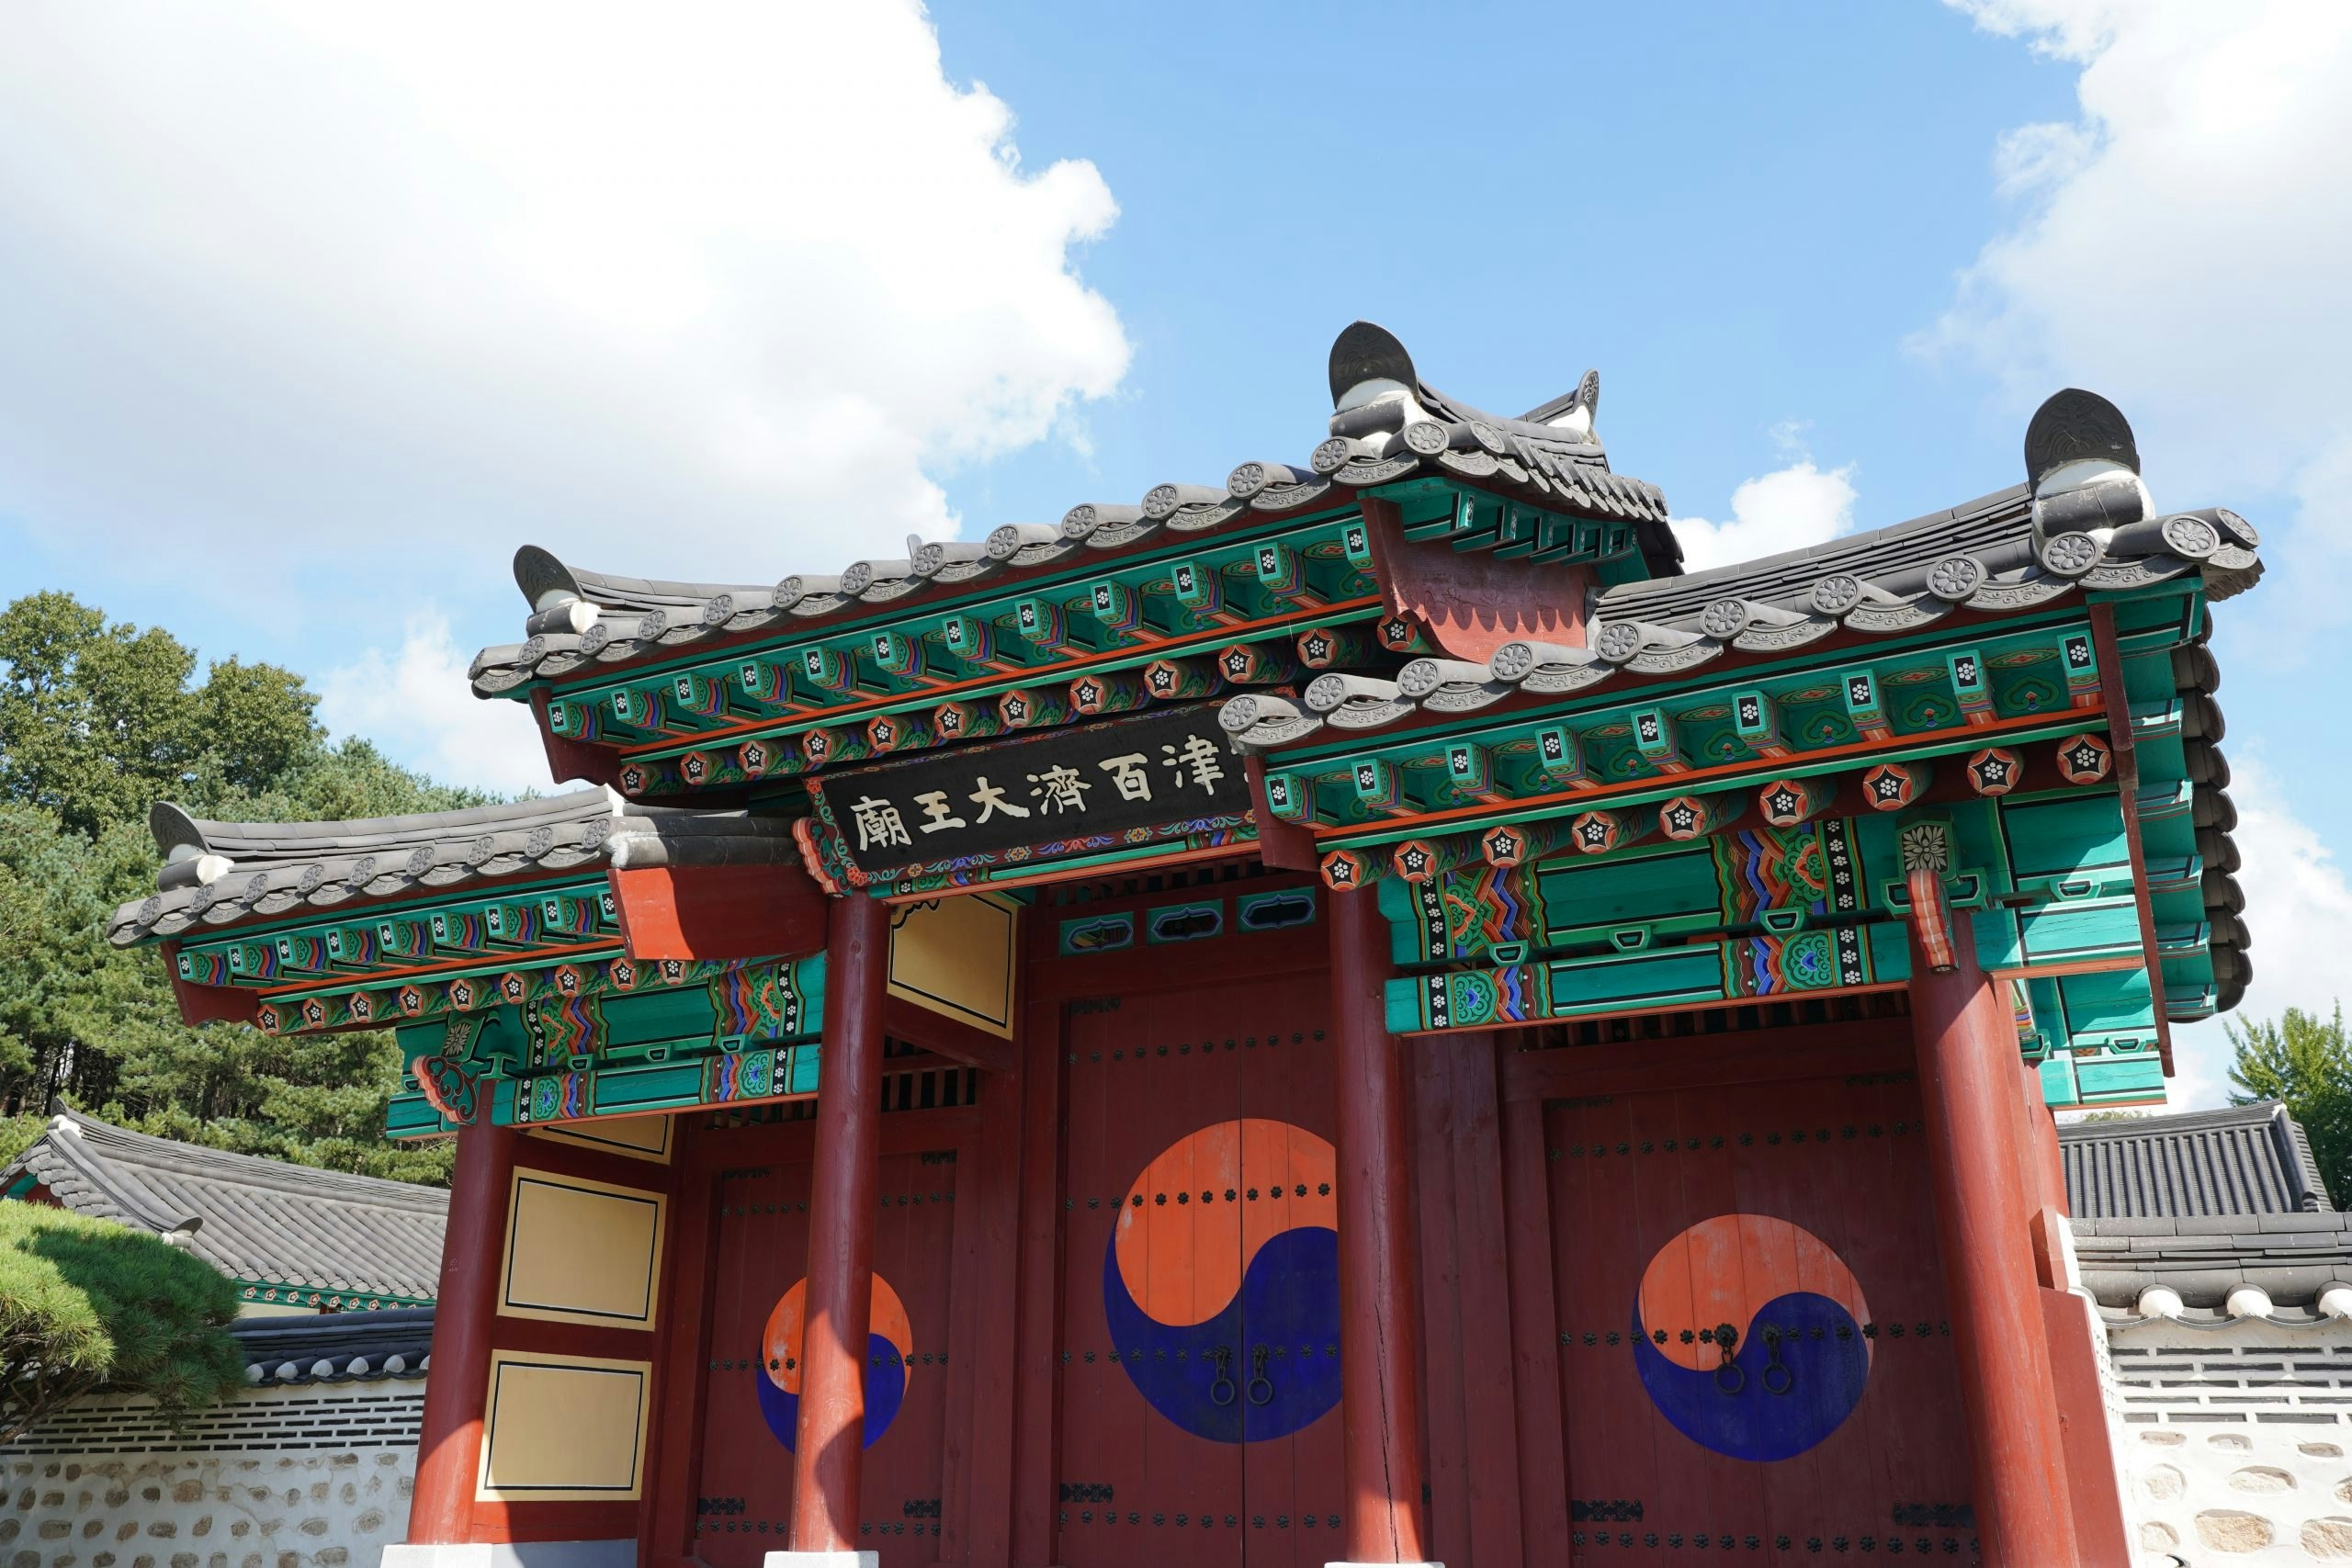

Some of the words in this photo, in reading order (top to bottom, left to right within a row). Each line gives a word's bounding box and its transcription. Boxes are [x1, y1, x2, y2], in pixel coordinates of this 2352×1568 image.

[850, 734, 1249, 852] 津百濟大王廟
